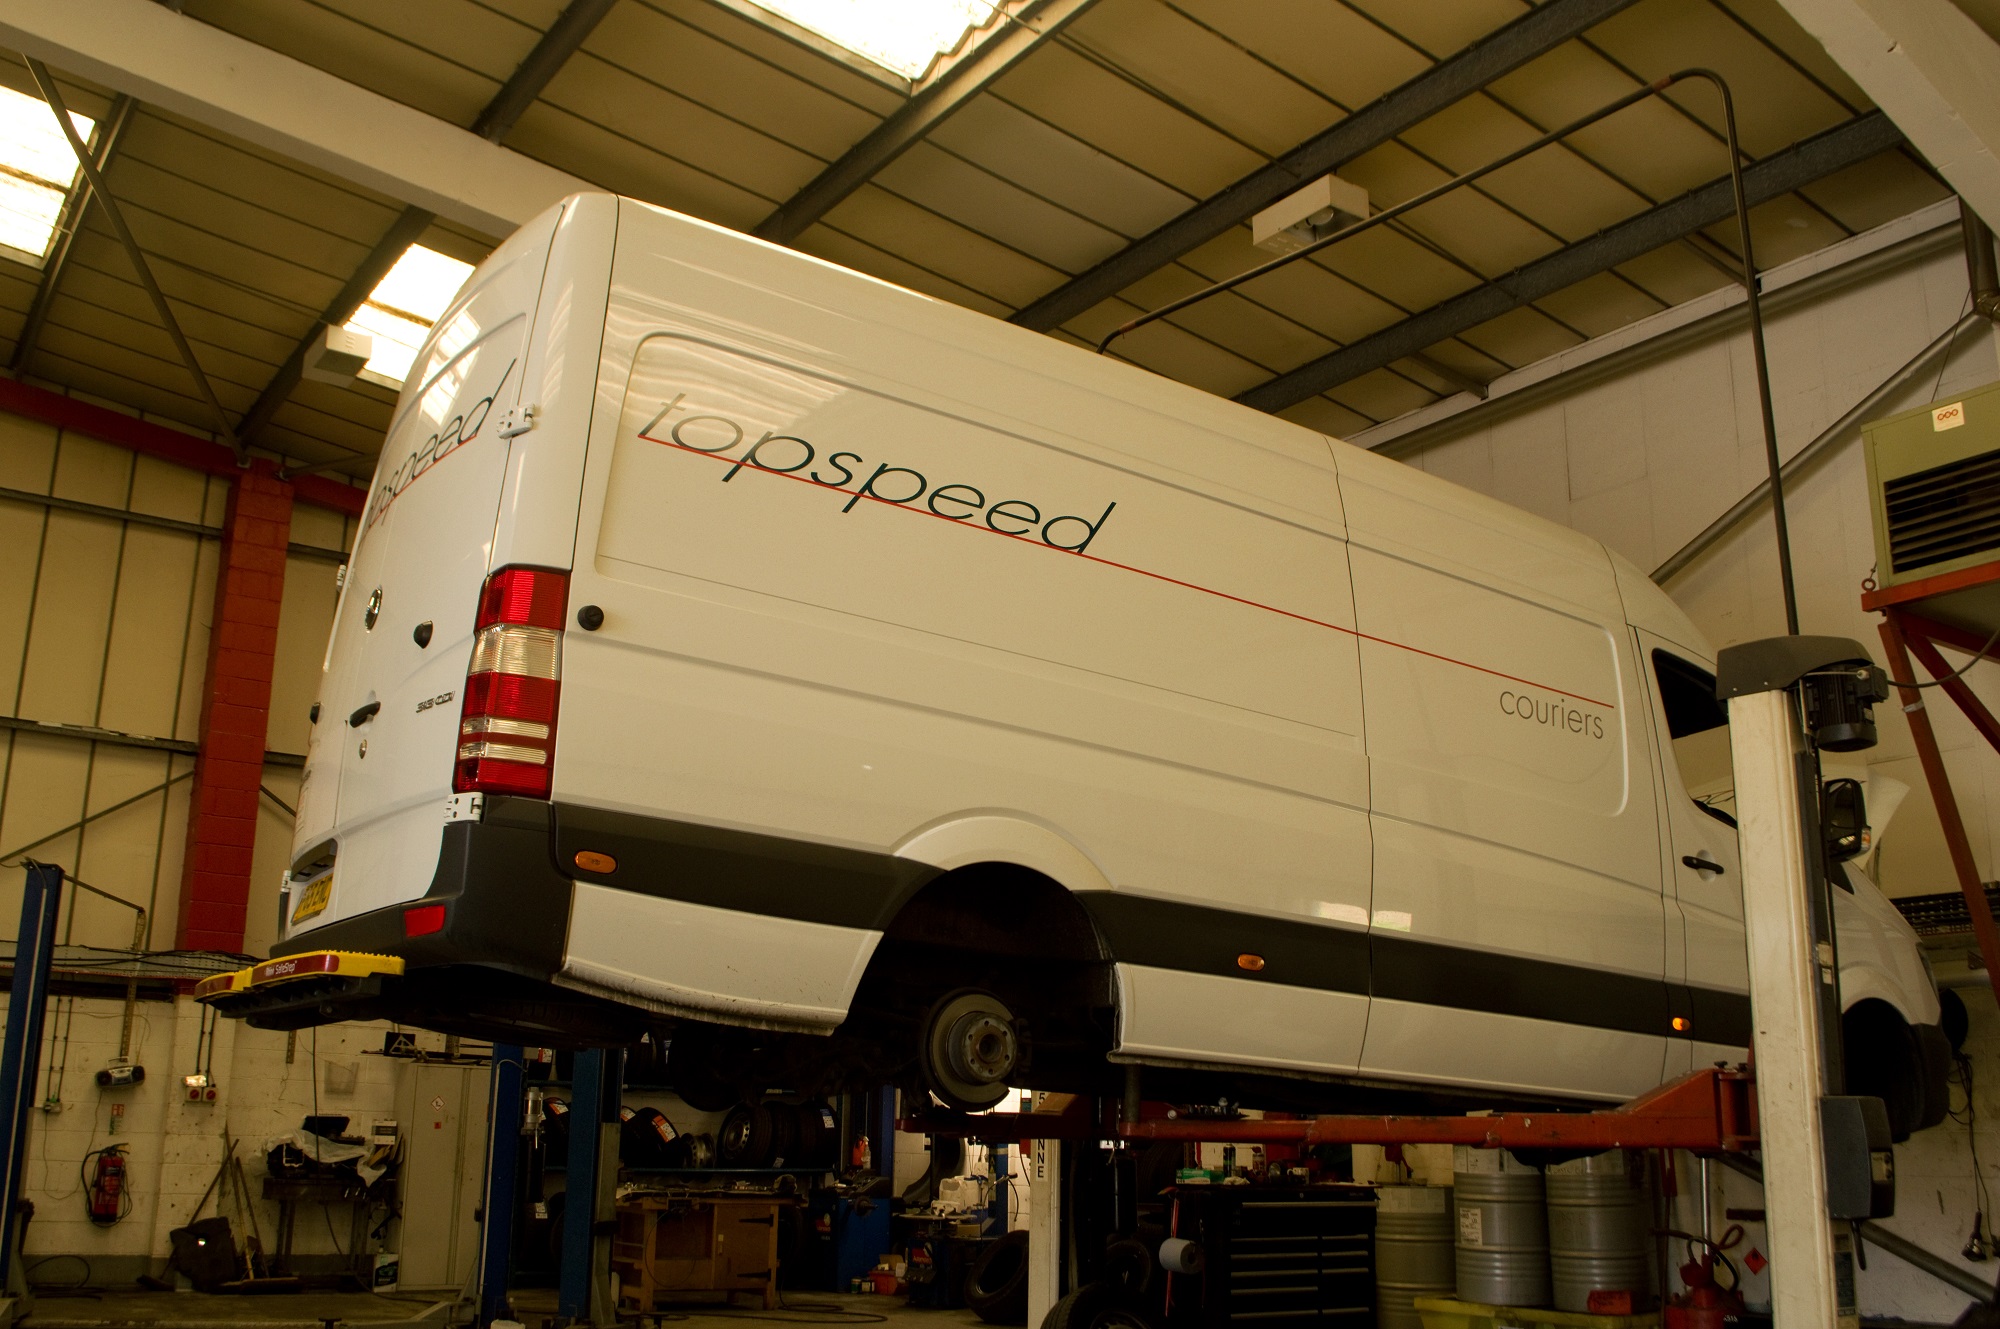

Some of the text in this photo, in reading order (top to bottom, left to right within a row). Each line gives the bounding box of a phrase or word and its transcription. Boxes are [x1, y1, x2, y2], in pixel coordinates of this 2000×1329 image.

[638, 393, 1117, 555] topspeed
[435, 690, 455, 705] CDI
[1500, 691, 1604, 740] couriers
[1037, 1138, 1045, 1178] NNE
